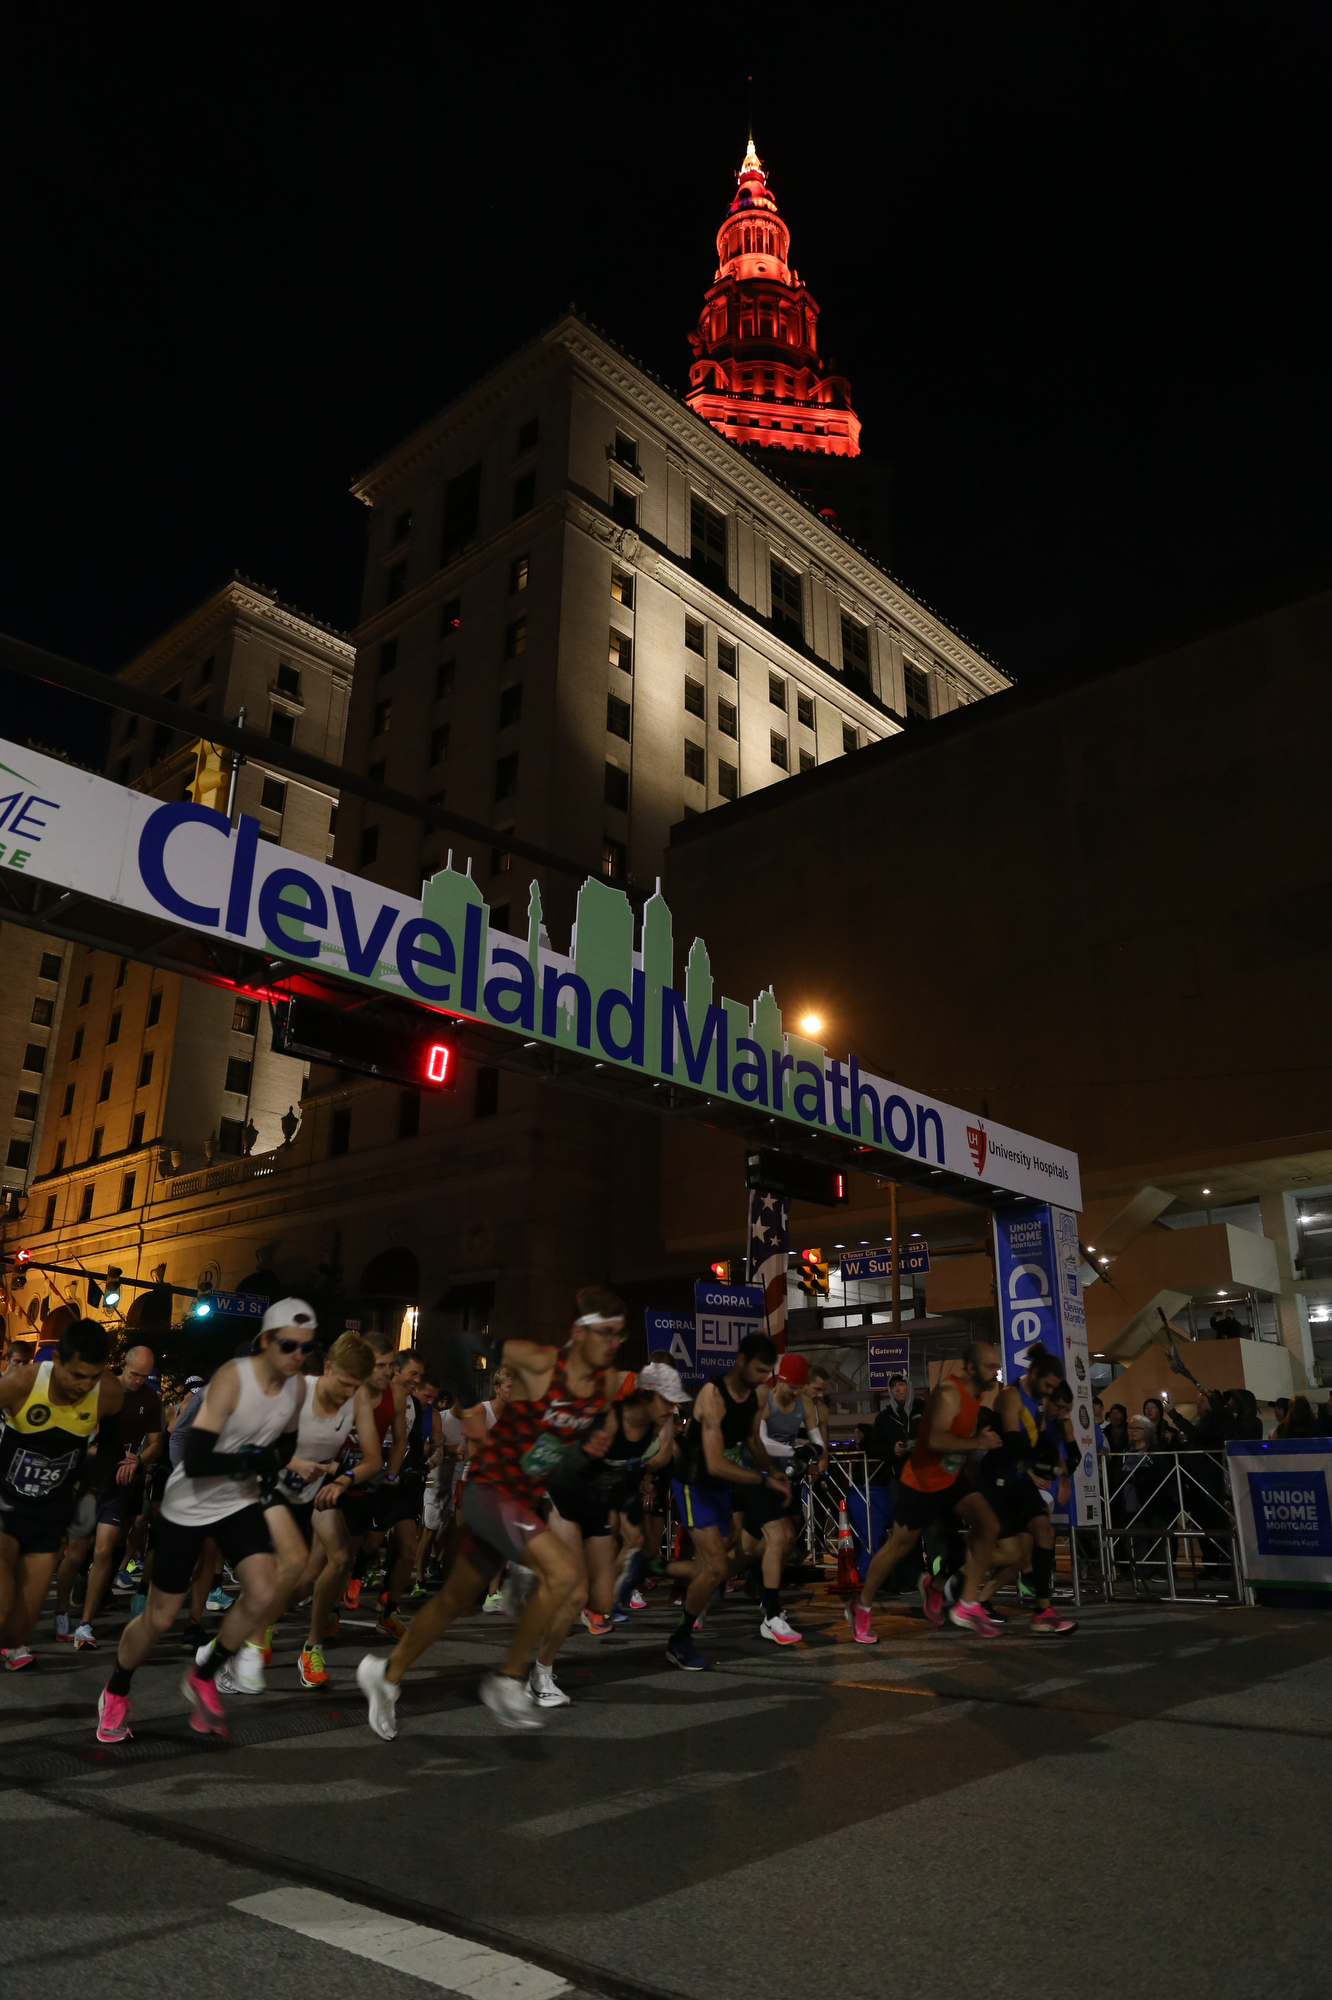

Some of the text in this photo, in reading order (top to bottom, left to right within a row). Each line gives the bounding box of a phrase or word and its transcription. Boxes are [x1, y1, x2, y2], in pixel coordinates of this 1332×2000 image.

[138, 800, 946, 1165] Cleveland Marathon
[427, 1045, 449, 1082] 0
[968, 1131, 979, 1146] UH
[989, 1140, 1069, 1180] University Hospitals
[1009, 1221, 1042, 1233] UNION
[1010, 1230, 1042, 1244] HOME
[887, 1245, 920, 1254] Weuse
[1010, 1241, 1042, 1249] MORTGAGE
[865, 1249, 877, 1257] City
[845, 1257, 924, 1275] W. Suprior
[216, 1297, 262, 1314] W. 3 St
[706, 1293, 753, 1308] CORRAL
[654, 1319, 696, 1330] CORRAL
[1009, 1263, 1053, 1378] Clev
[667, 1332, 694, 1368] A
[701, 1357, 716, 1366] RUN
[870, 1370, 884, 1378] Flats
[24, 1465, 61, 1481] 1126
[1261, 1490, 1316, 1504] UNION
[1263, 1505, 1318, 1521] HOME
[1266, 1521, 1319, 1531] MORTGAGE
[1269, 1538, 1300, 1546] Promises
